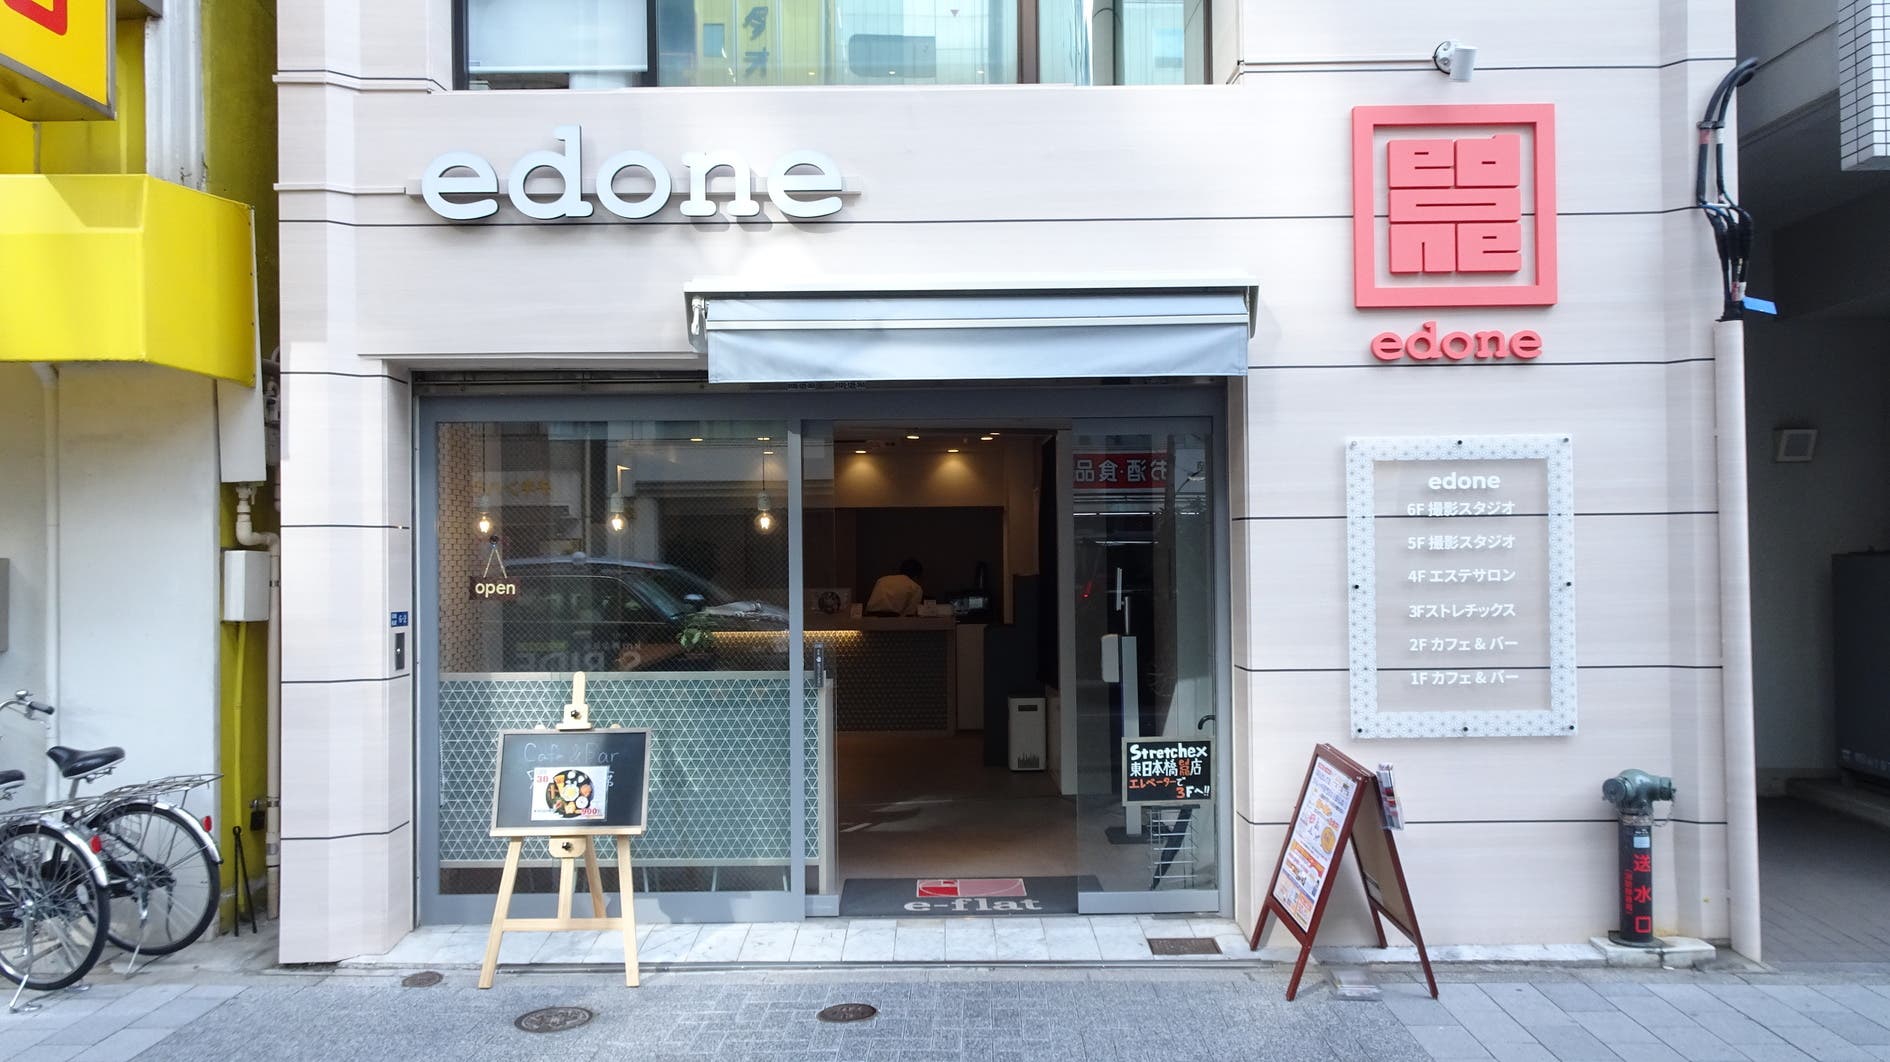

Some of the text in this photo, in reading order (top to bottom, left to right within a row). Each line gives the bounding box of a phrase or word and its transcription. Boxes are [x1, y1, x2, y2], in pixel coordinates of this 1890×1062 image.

[421, 124, 843, 220] edone
[1371, 321, 1542, 361] edone
[1428, 472, 1501, 489] edone
[1407, 501, 1516, 516] 6F 撮影スタジオ
[1407, 534, 1516, 550] 5F 撮影スタジオ
[1408, 568, 1516, 583] 4F エステサロン
[475, 583, 516, 598] open
[1409, 638, 1427, 651] 2F
[1411, 672, 1428, 685] 1F
[1129, 742, 1208, 760] Stretchex
[1633, 853, 1652, 933] 送水口
[904, 898, 1042, 912] e-flat
